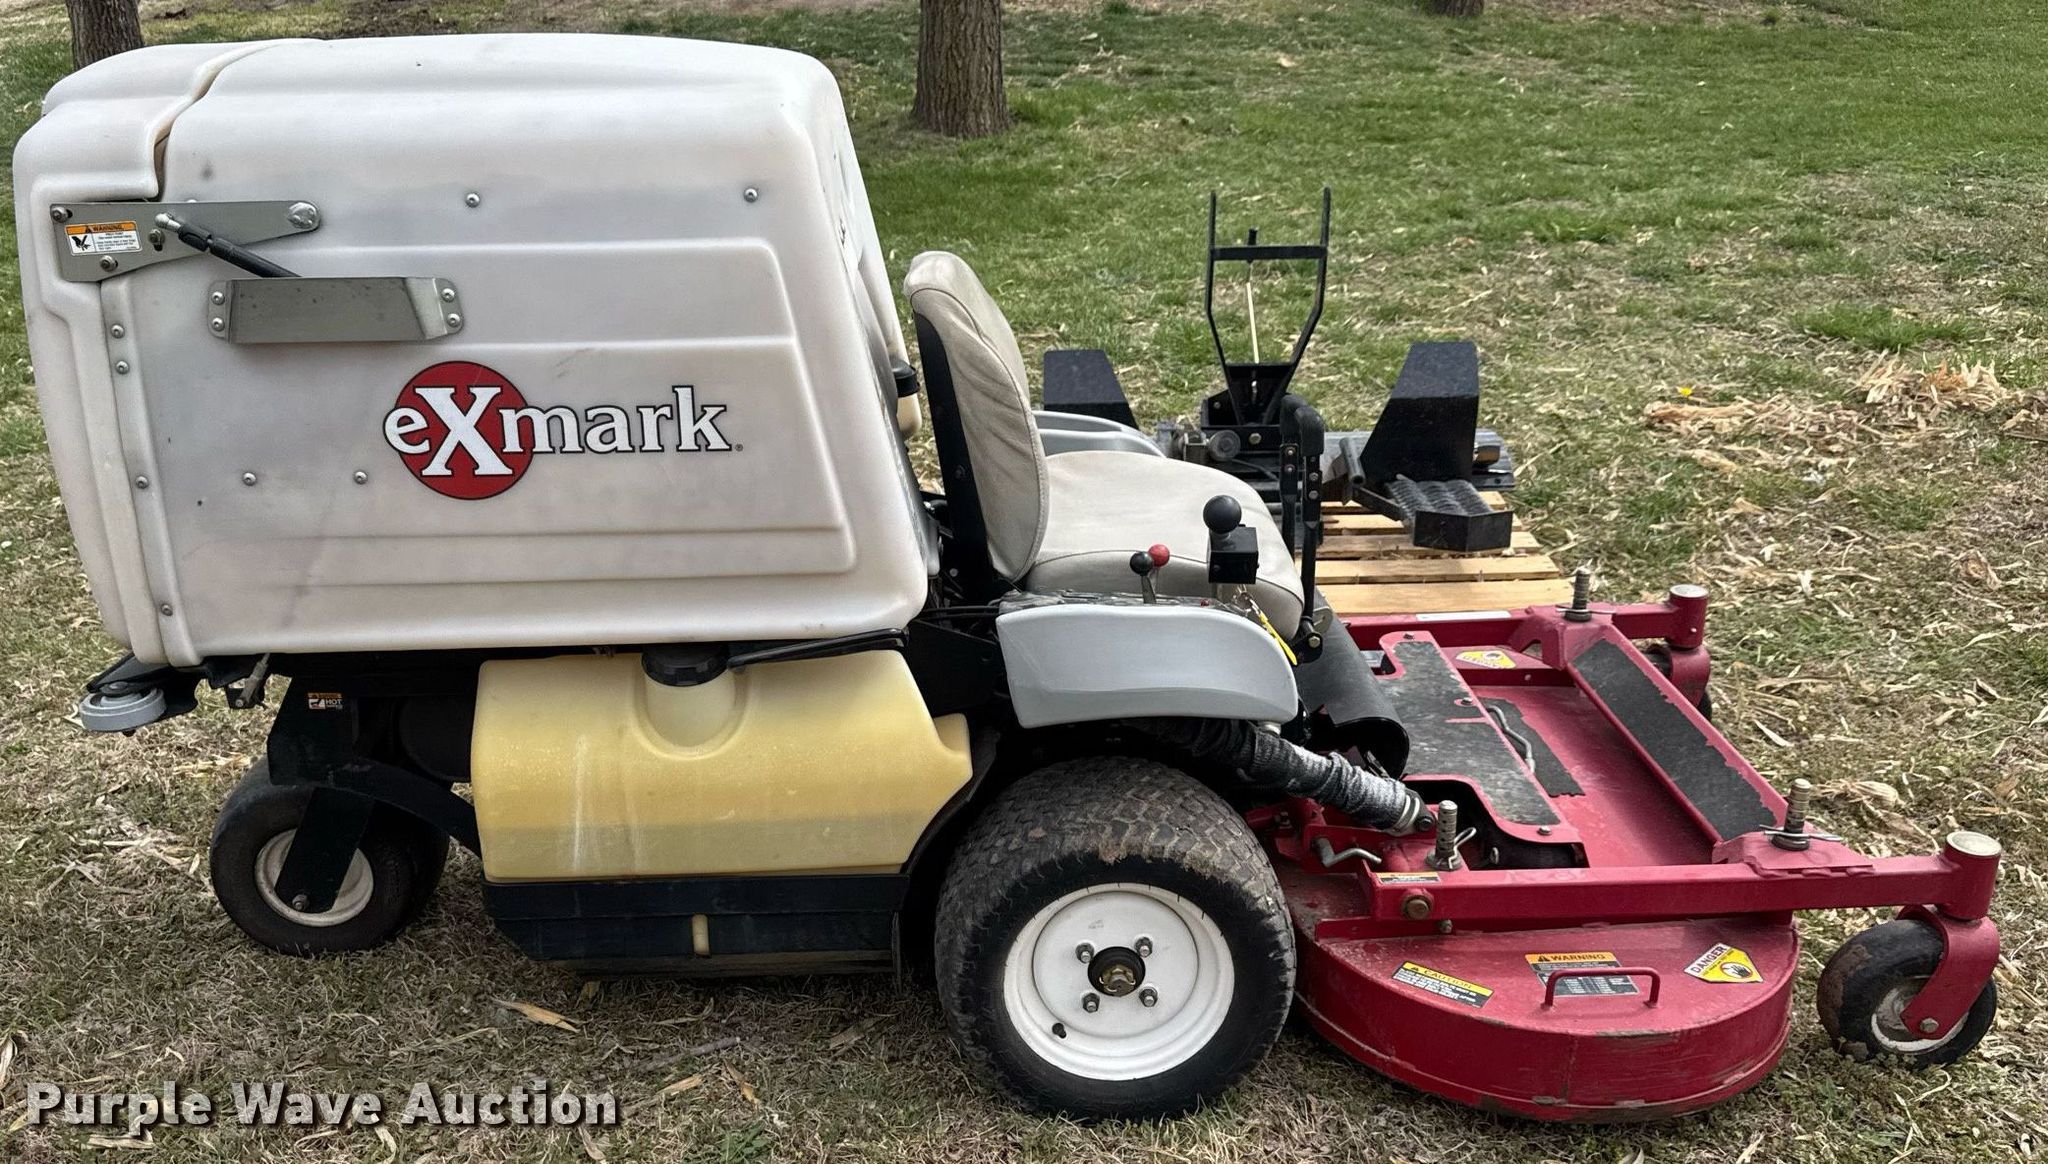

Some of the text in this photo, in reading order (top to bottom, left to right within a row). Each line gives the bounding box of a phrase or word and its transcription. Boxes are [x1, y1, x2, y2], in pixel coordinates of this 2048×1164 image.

[93, 224, 122, 232] WARNING
[1551, 953, 1606, 961] WARNING
[1690, 945, 1727, 974] DANGER
[1423, 968, 1473, 990] CAUTION
